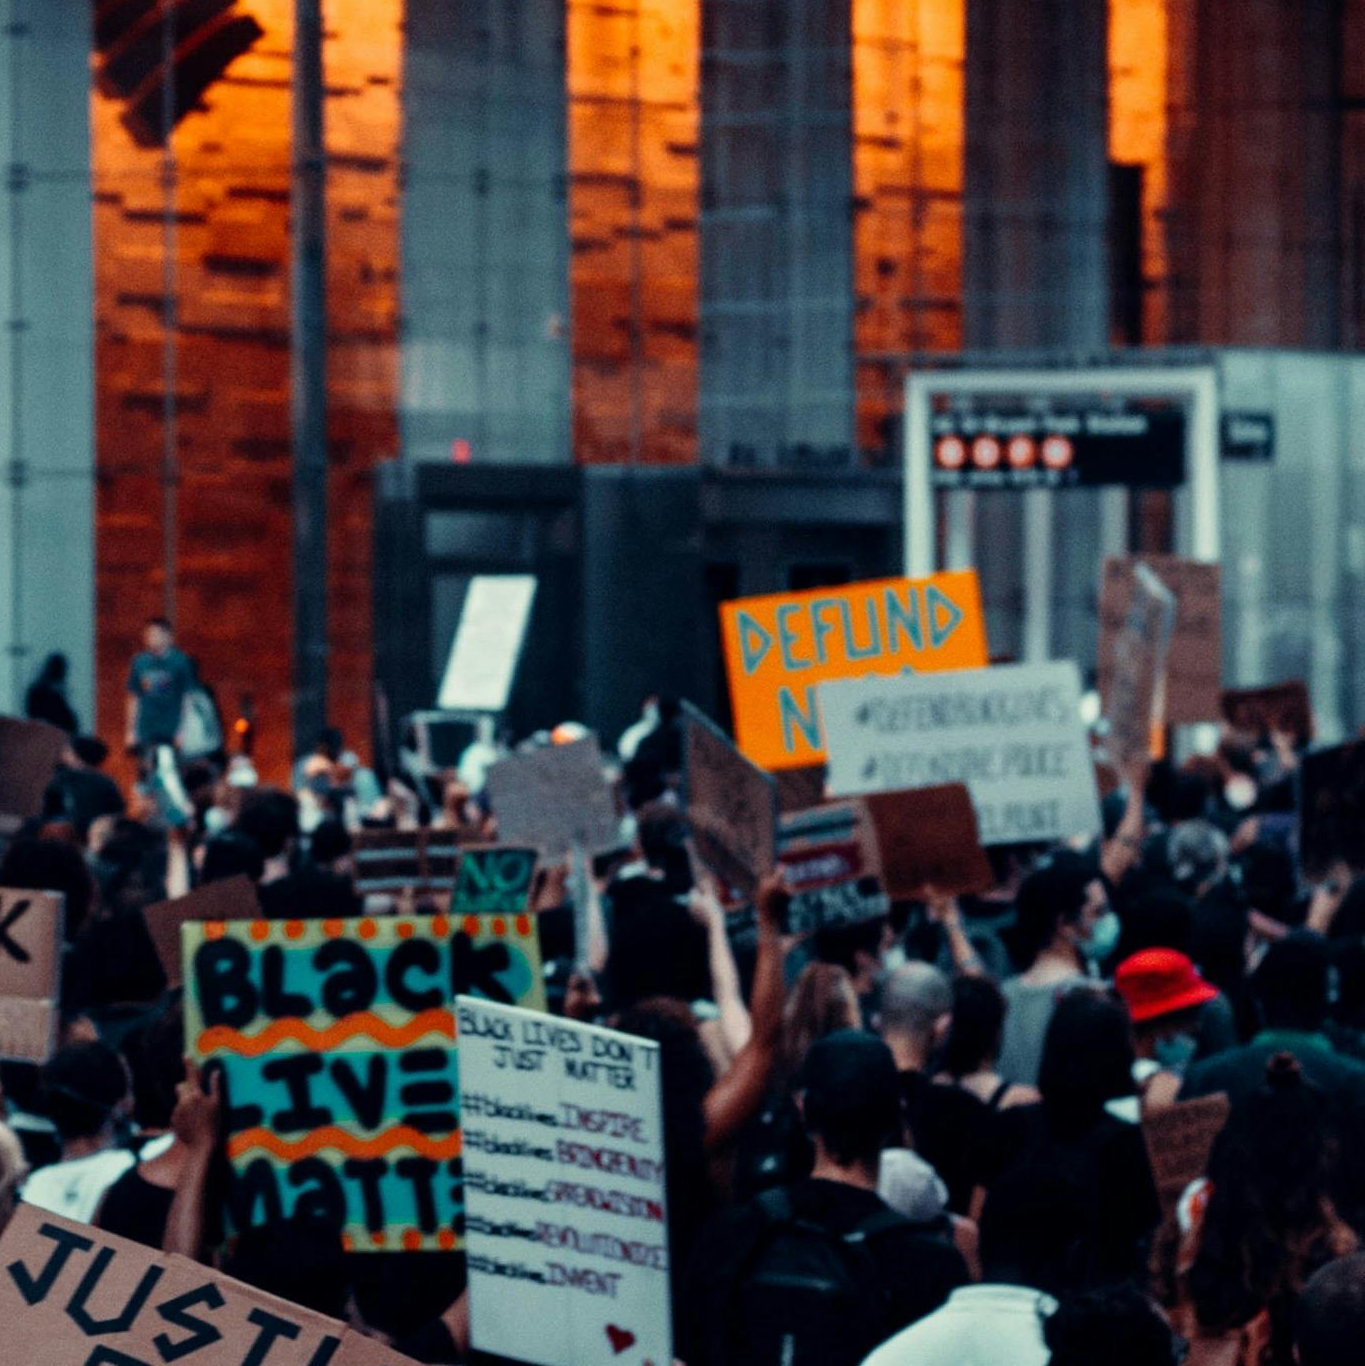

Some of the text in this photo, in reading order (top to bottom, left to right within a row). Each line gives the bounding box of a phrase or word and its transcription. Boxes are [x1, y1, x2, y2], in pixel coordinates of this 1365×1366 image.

[737, 584, 964, 674] DEFUND
[522, 1020, 582, 1052] LIVES
[492, 1044, 637, 1090] JUST MATTER
